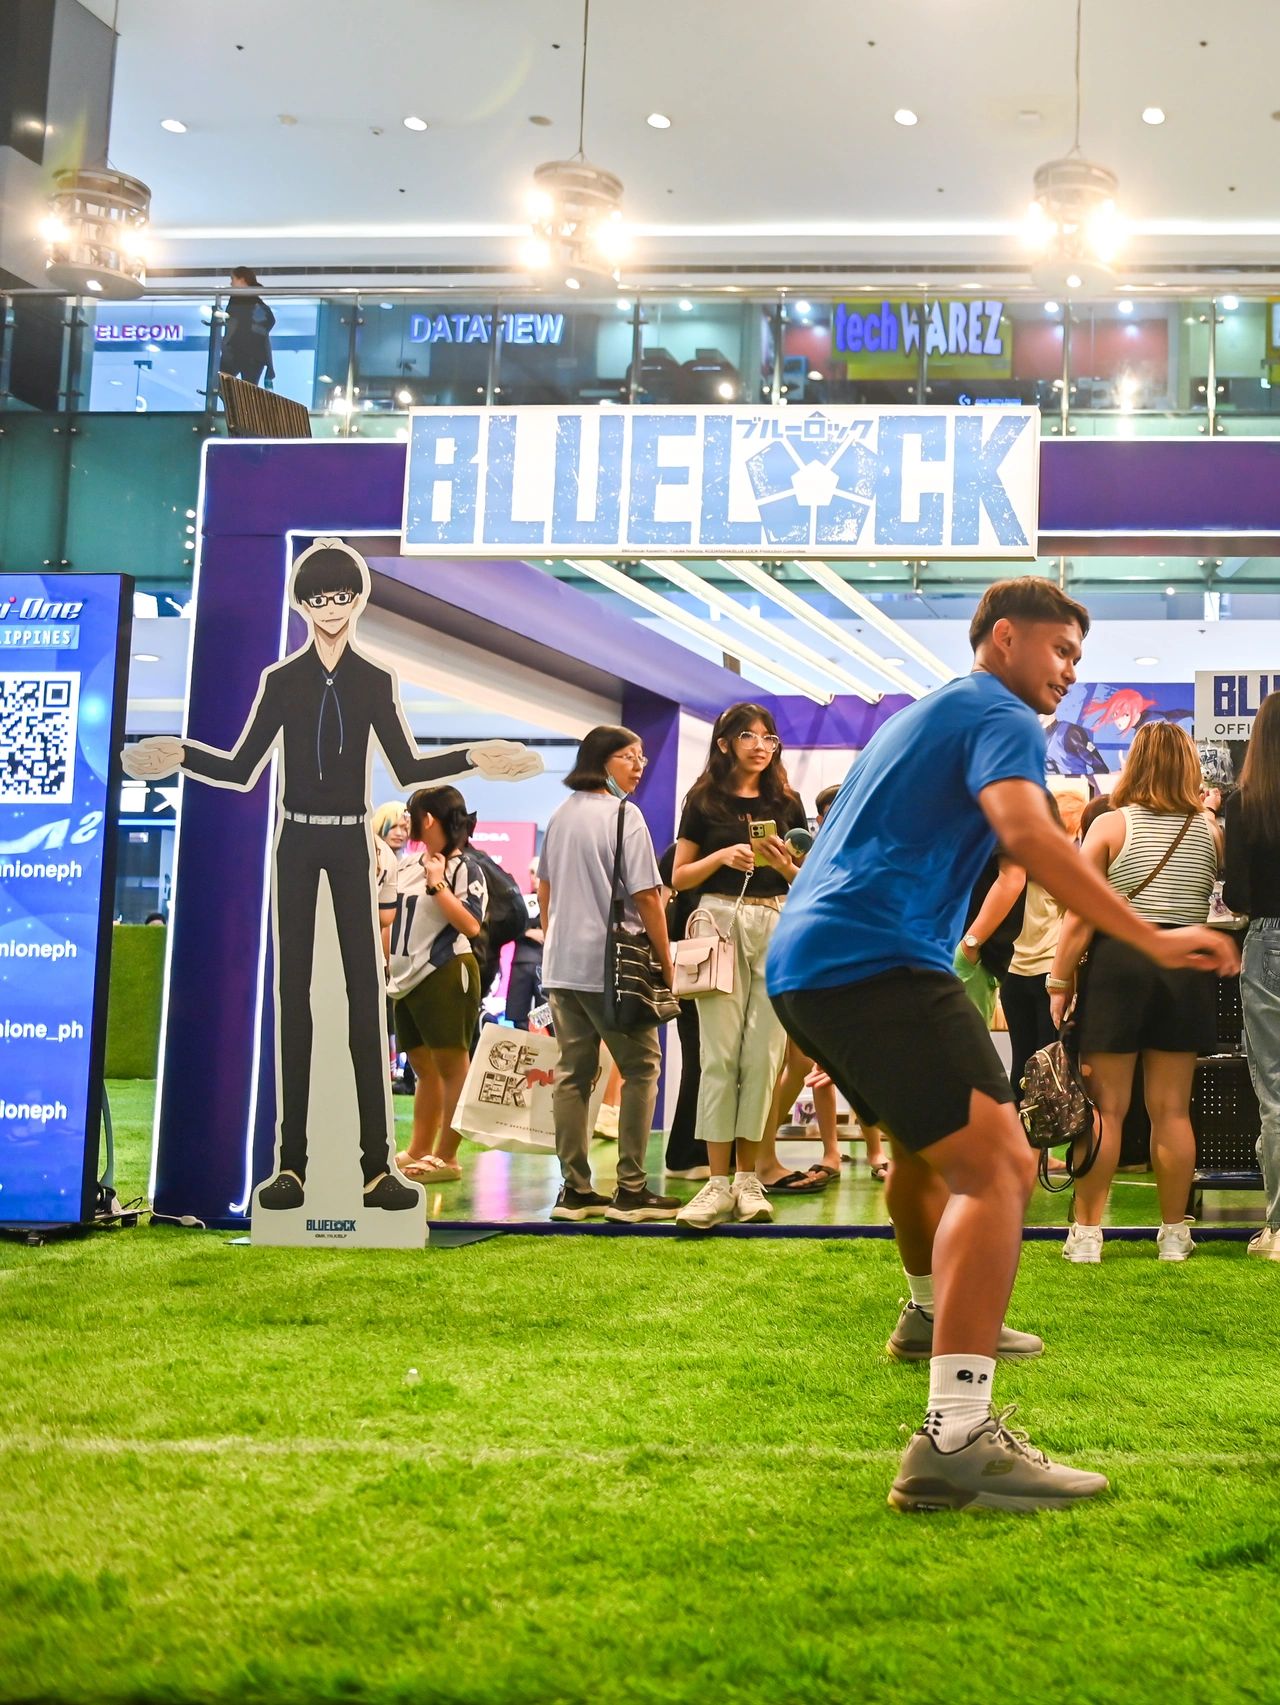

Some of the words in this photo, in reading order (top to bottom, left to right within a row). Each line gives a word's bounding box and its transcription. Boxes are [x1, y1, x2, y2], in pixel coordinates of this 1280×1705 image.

[94, 324, 184, 341] ELECOM
[736, 411, 874, 439] ブルーロック
[407, 414, 1032, 546] BLUELOCK
[0, 596, 84, 620] i-One
[0, 630, 71, 645] IPPINES
[1214, 723, 1250, 735] OFFI
[0, 860, 82, 882] nioneph
[0, 1020, 83, 1042] ione_ph
[306, 1219, 357, 1232] BLUELOCK
